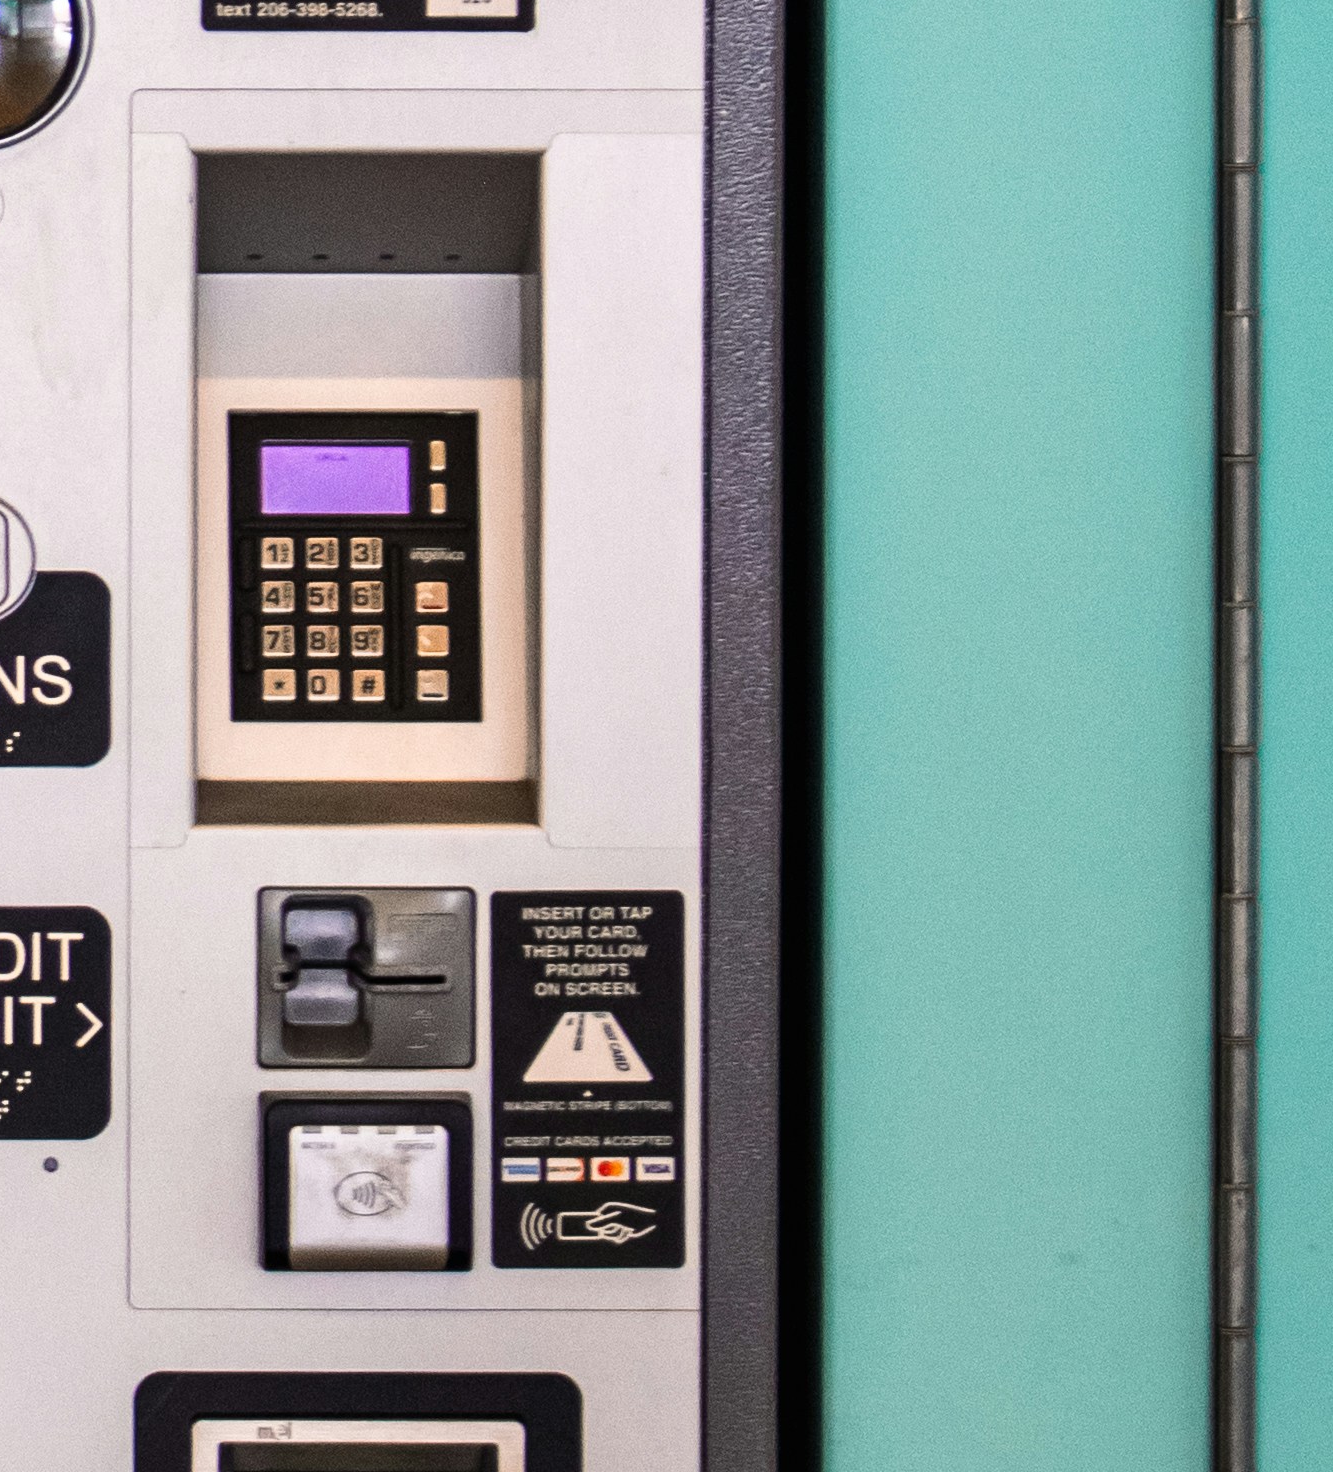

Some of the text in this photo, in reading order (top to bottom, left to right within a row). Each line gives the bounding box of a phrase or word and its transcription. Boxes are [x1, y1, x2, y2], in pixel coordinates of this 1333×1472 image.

[216, 3, 251, 16] text
[267, 544, 278, 562] 1
[308, 543, 324, 562] 2
[352, 543, 369, 562] 3
[265, 587, 280, 606] 4
[309, 587, 324, 606] 5
[353, 587, 369, 606] 6
[265, 631, 280, 650] 7
[309, 631, 326, 650] 8
[353, 631, 369, 650] 9
[523, 907, 652, 920] INSERT OR TAP
[534, 926, 582, 939] YOUR
[523, 944, 647, 958] THEN FOLLOW
[546, 963, 629, 976] PROMPTS
[535, 982, 560, 996] ON
